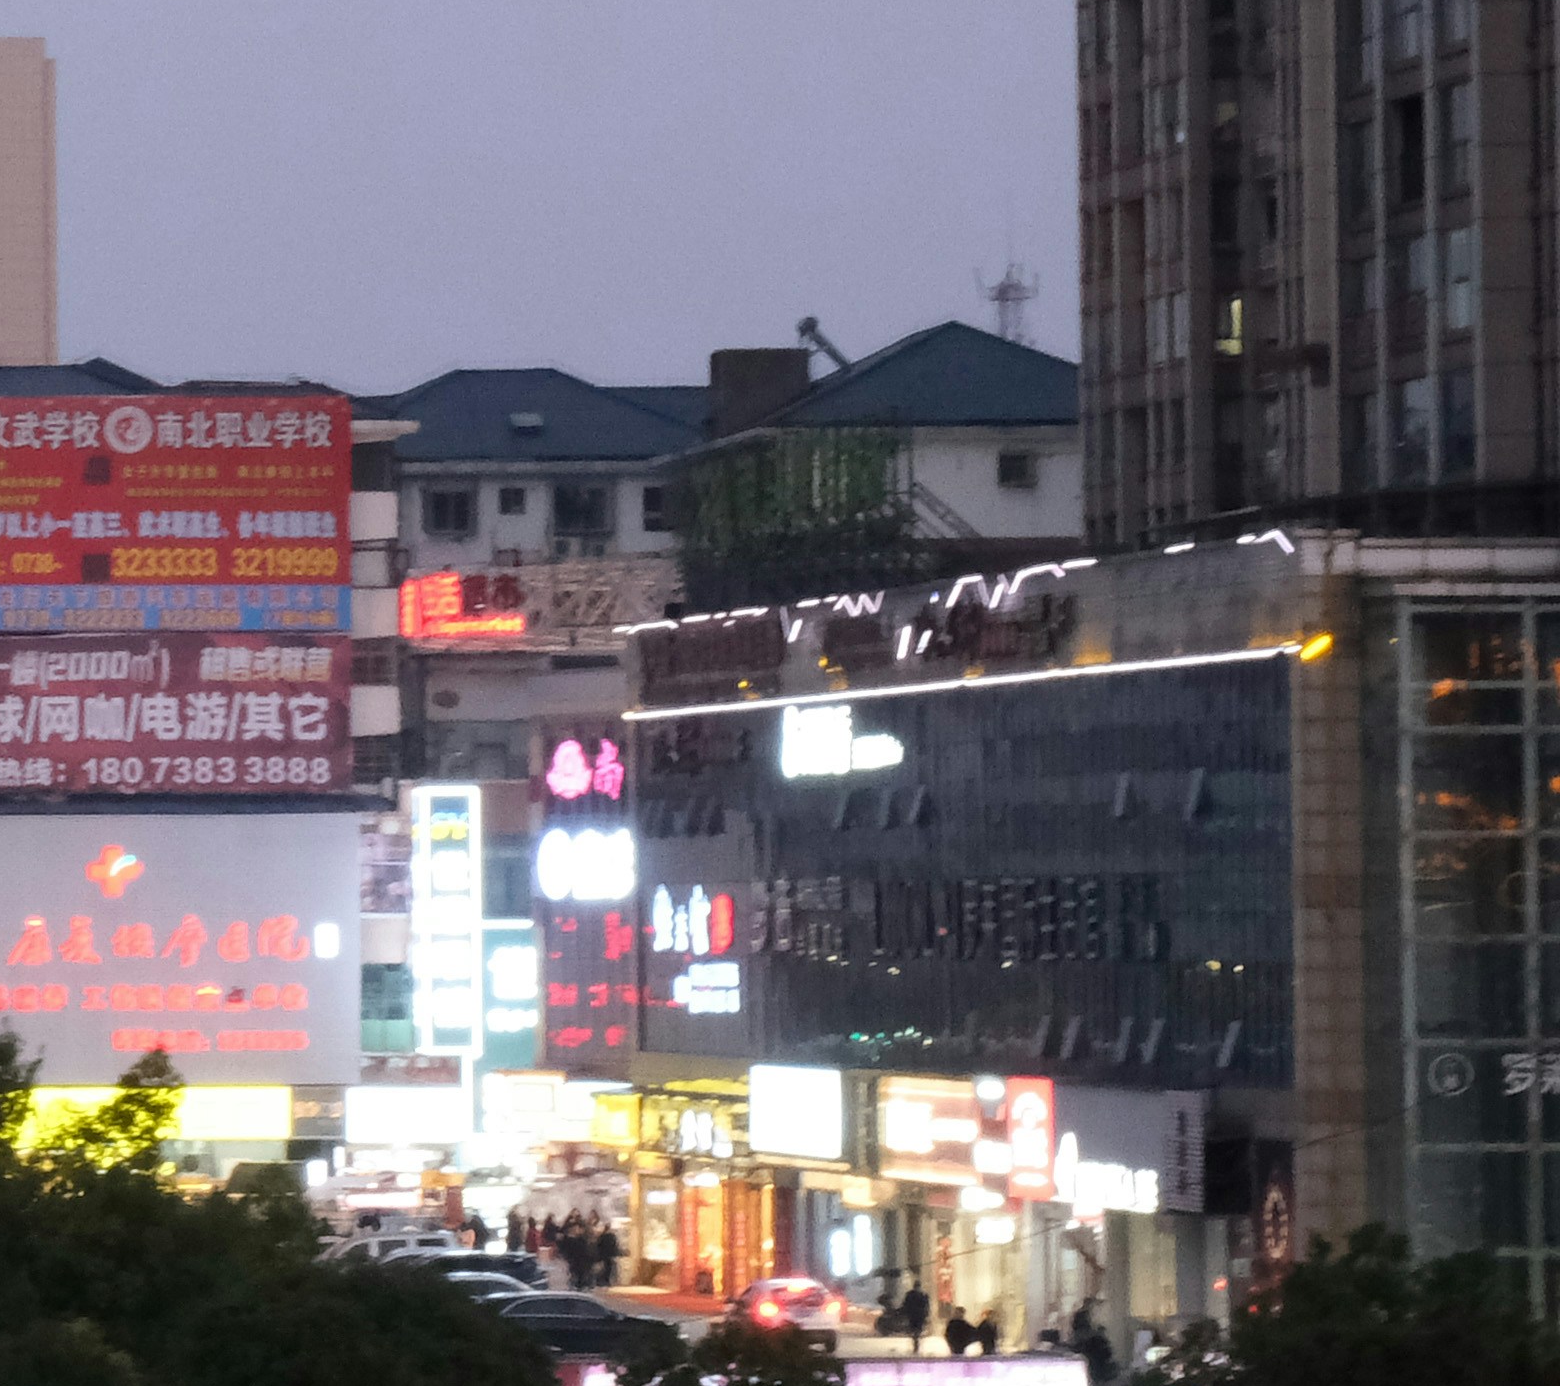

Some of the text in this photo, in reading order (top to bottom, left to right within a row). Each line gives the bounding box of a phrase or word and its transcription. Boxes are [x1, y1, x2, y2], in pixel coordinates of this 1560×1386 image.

[156, 410, 333, 449] 南北职业学校
[111, 547, 218, 578] 3233333
[82, 759, 145, 785] 180
[151, 758, 237, 784] 7383
[244, 757, 332, 785] 3888
